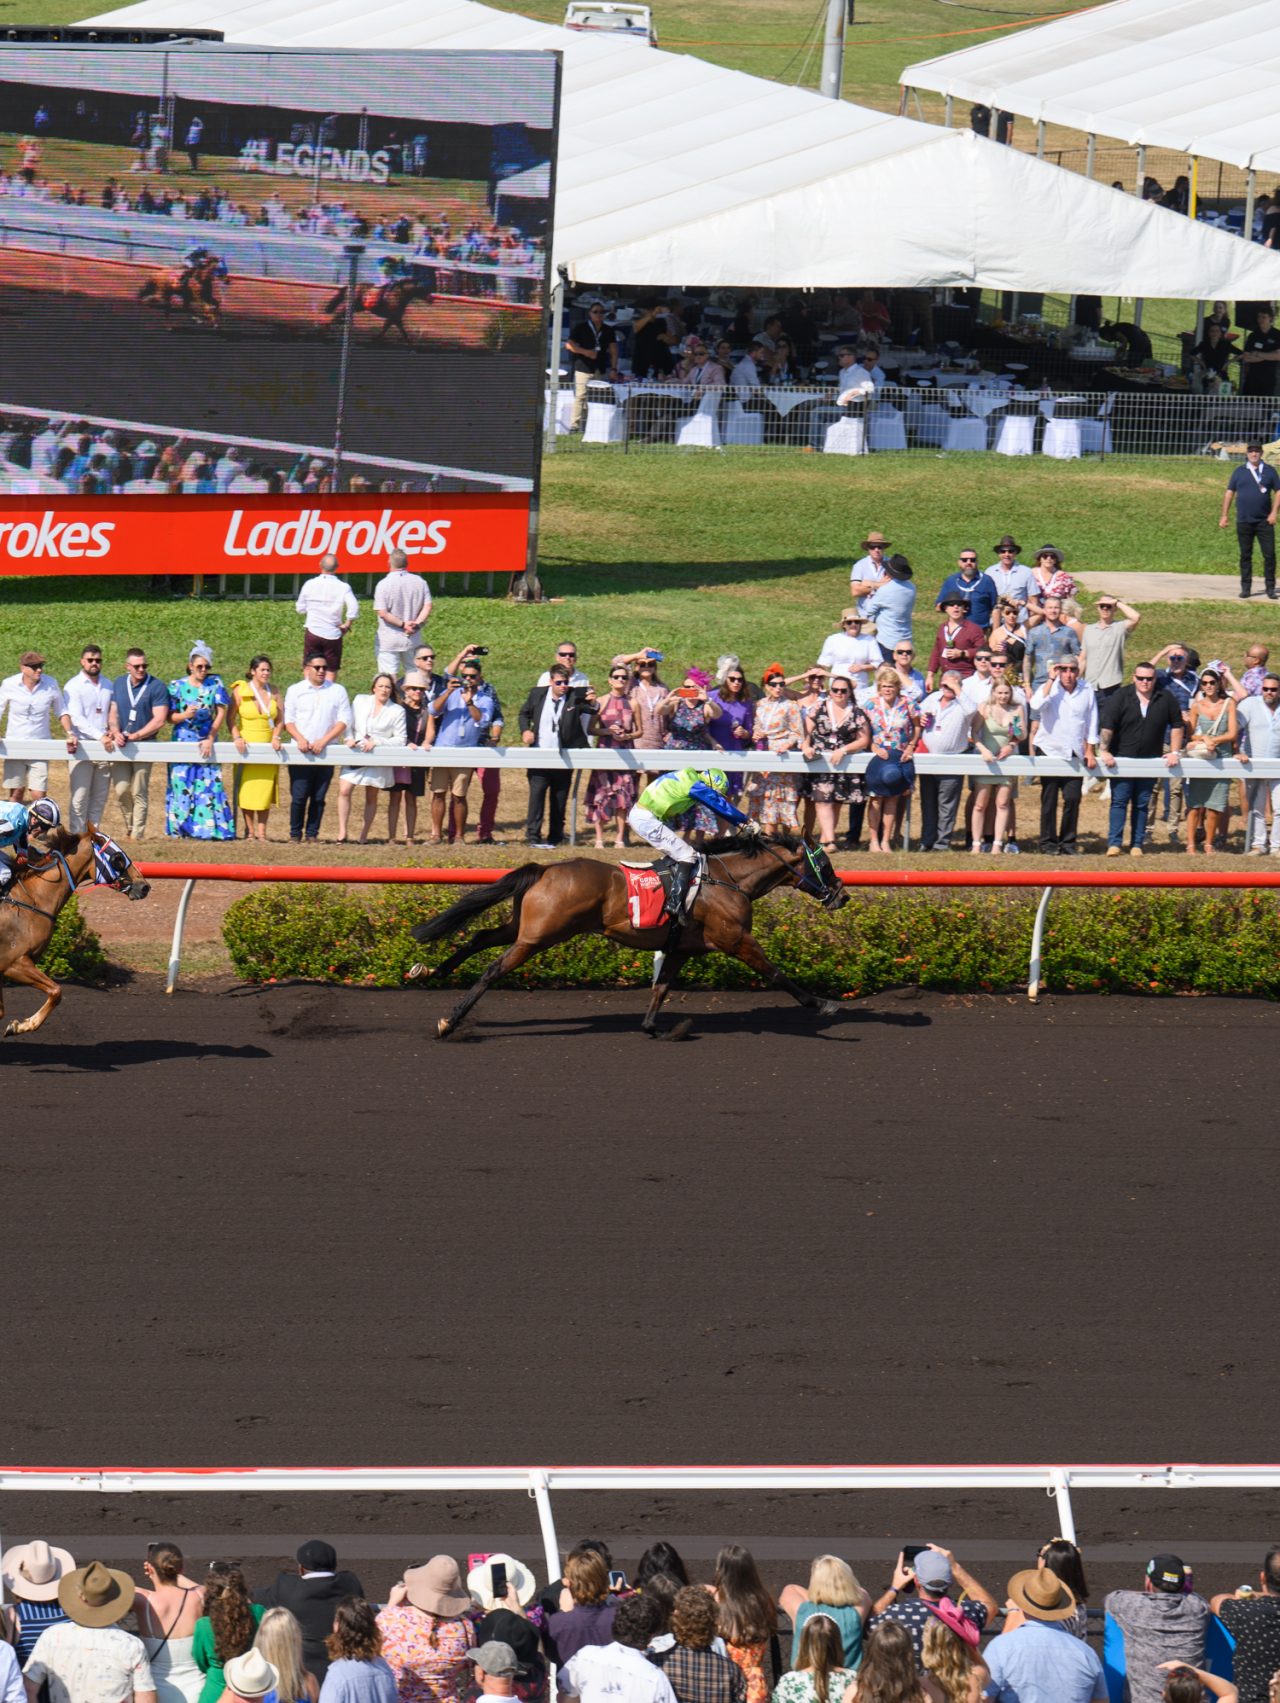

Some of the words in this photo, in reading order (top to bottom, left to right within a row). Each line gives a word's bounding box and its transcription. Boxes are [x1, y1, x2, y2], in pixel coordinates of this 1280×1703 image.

[238, 140, 390, 184] #LEGENDS
[223, 509, 452, 556] Ladbrokes
[628, 895, 641, 928] 1
